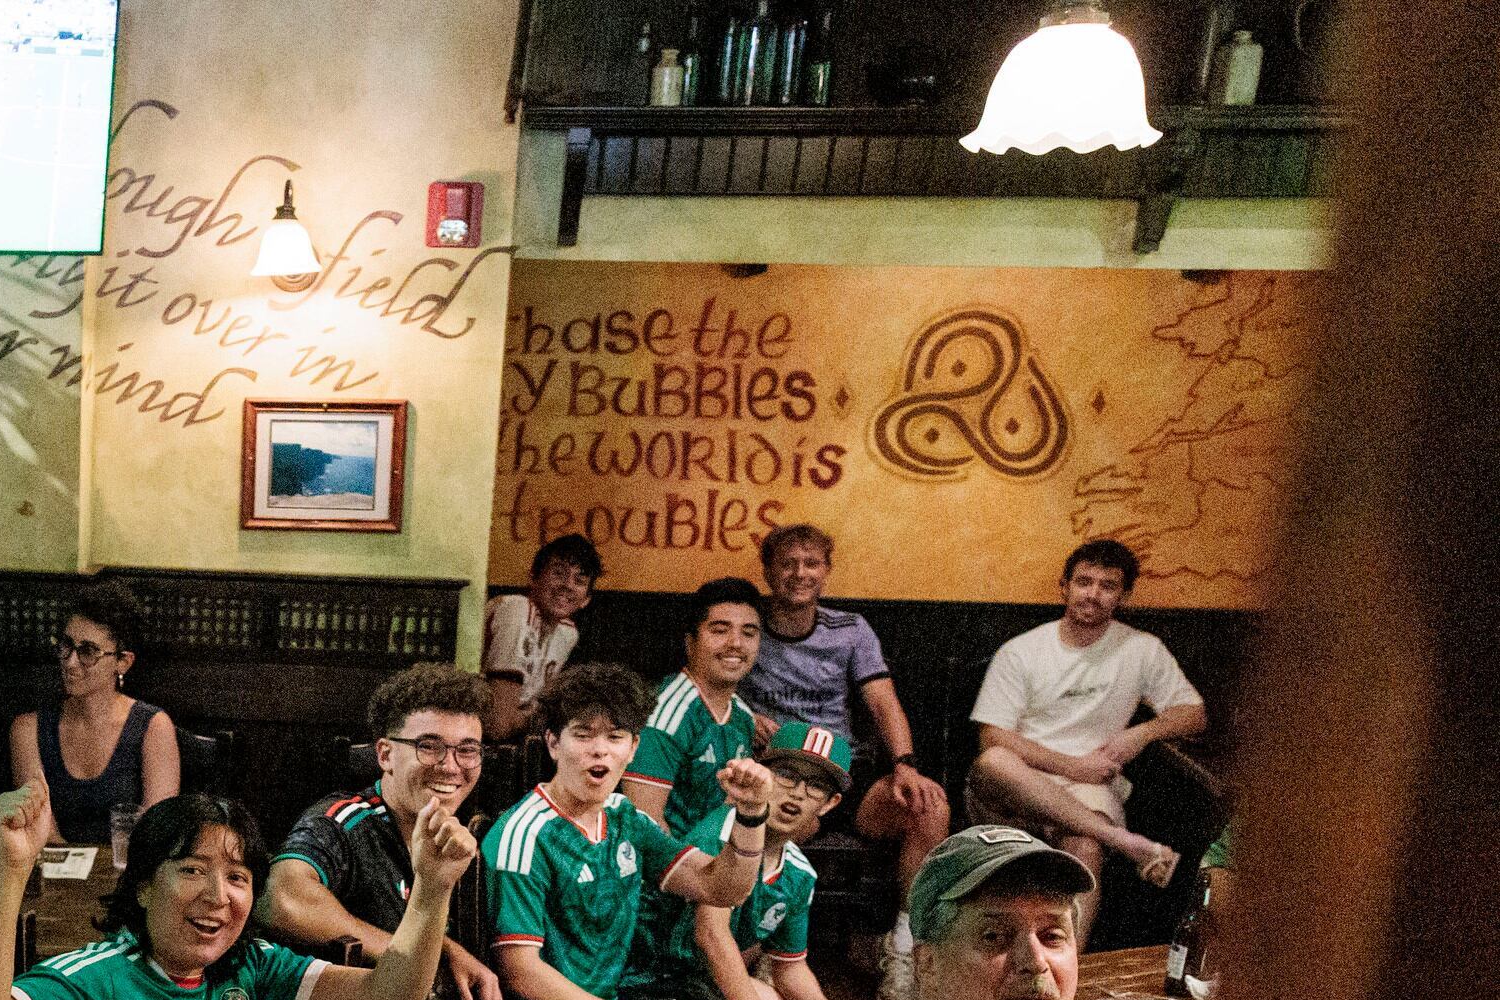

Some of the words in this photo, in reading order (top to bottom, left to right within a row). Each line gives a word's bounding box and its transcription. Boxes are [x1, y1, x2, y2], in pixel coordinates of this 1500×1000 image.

[269, 210, 520, 339] field
[96, 249, 159, 308] it
[162, 293, 289, 356] over
[289, 326, 380, 392] in
[506, 306, 677, 356] hase
[688, 296, 794, 359] the
[47, 342, 258, 428] mind
[791, 436, 847, 489] is
